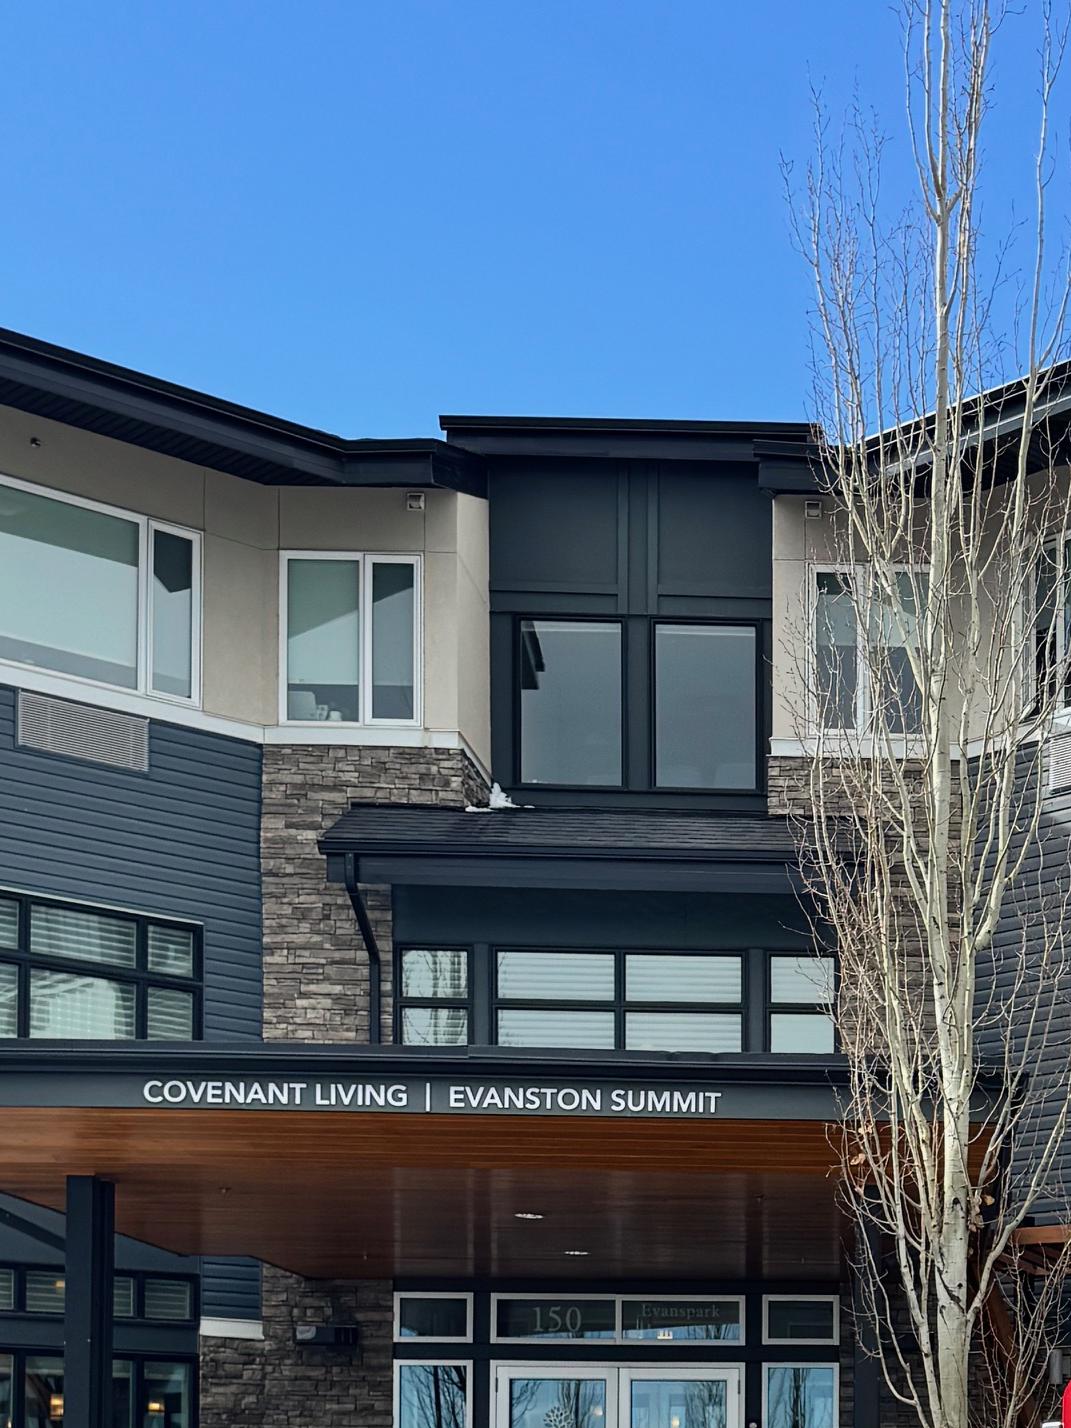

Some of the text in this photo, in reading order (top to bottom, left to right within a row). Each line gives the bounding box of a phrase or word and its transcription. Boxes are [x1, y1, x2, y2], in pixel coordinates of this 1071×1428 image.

[143, 1080, 307, 1105] COVENANT
[315, 1083, 407, 1107] LIVING
[449, 1086, 601, 1111] EVANSTON
[610, 1089, 722, 1113] SUMMIT
[532, 1306, 582, 1333] 150
[641, 1303, 721, 1321] Evanspark
